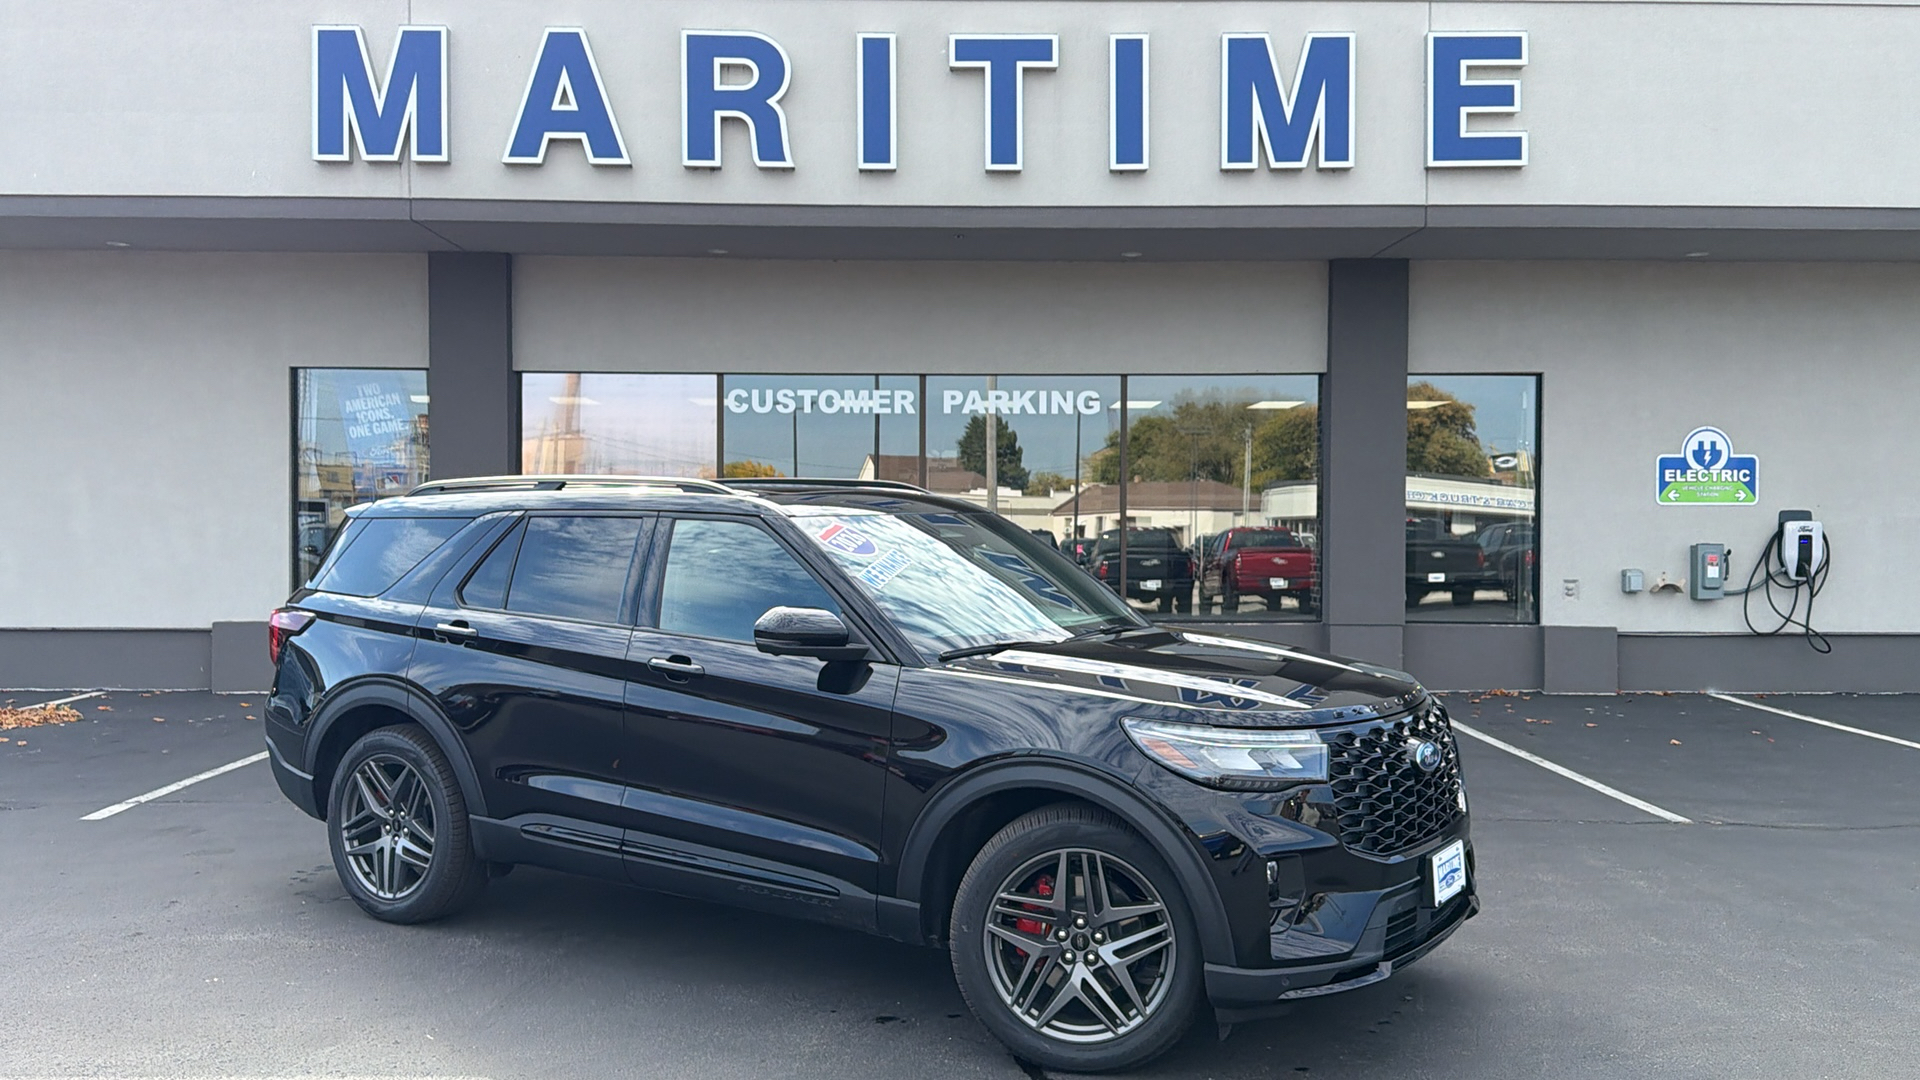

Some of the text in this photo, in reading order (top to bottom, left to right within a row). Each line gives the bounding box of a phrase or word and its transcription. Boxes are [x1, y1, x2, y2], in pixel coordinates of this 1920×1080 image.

[311, 24, 1529, 172] MARITIME
[357, 383, 380, 396] TWO
[345, 392, 401, 414] AMERICAN
[726, 388, 1101, 415] CUSTOMER PARKING
[356, 408, 395, 424] ICONS.
[348, 418, 409, 439] ONE GAME.
[1664, 469, 1751, 482] ELECTRIC
[831, 529, 868, 552] 2026
[869, 549, 912, 579] FINANCE
